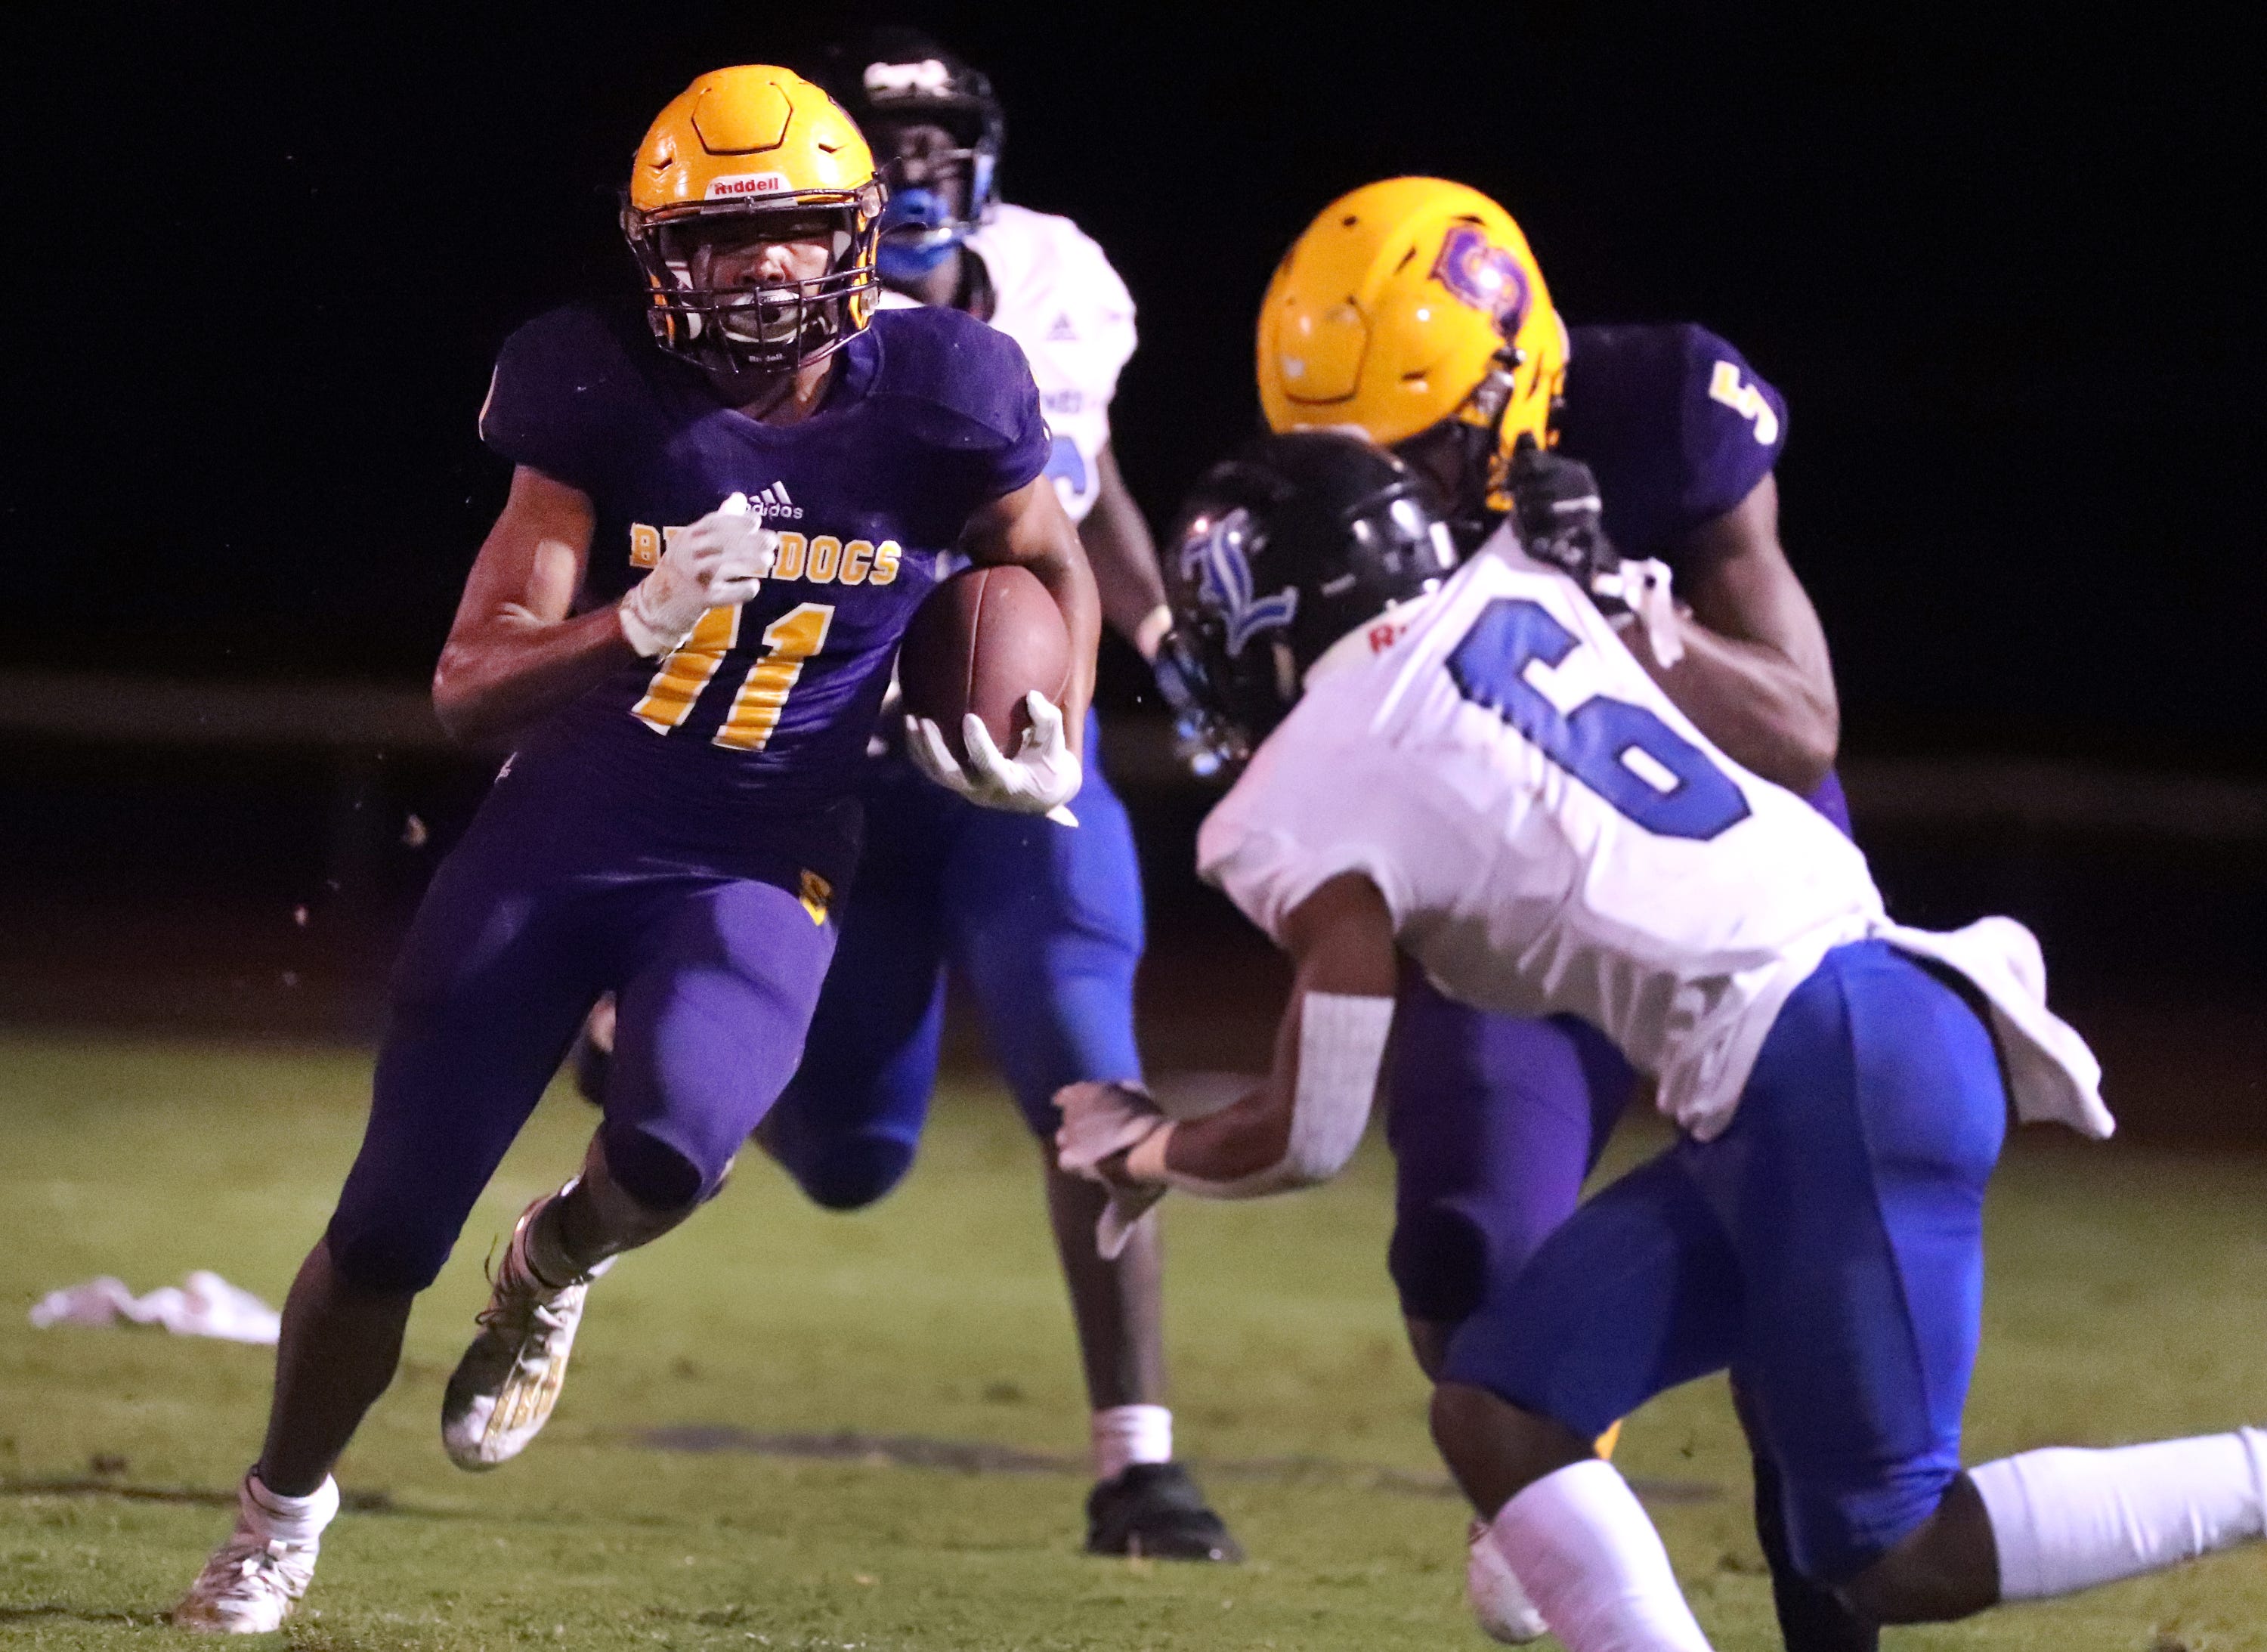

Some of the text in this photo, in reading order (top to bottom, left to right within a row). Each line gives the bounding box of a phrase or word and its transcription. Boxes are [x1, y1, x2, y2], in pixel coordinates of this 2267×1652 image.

[714, 178, 779, 195] Riddell
[1709, 360, 1779, 445] 5
[629, 522, 902, 586] BDOGS
[1180, 506, 1299, 659] L
[629, 602, 836, 753] 11
[1444, 596, 1752, 840] 6
